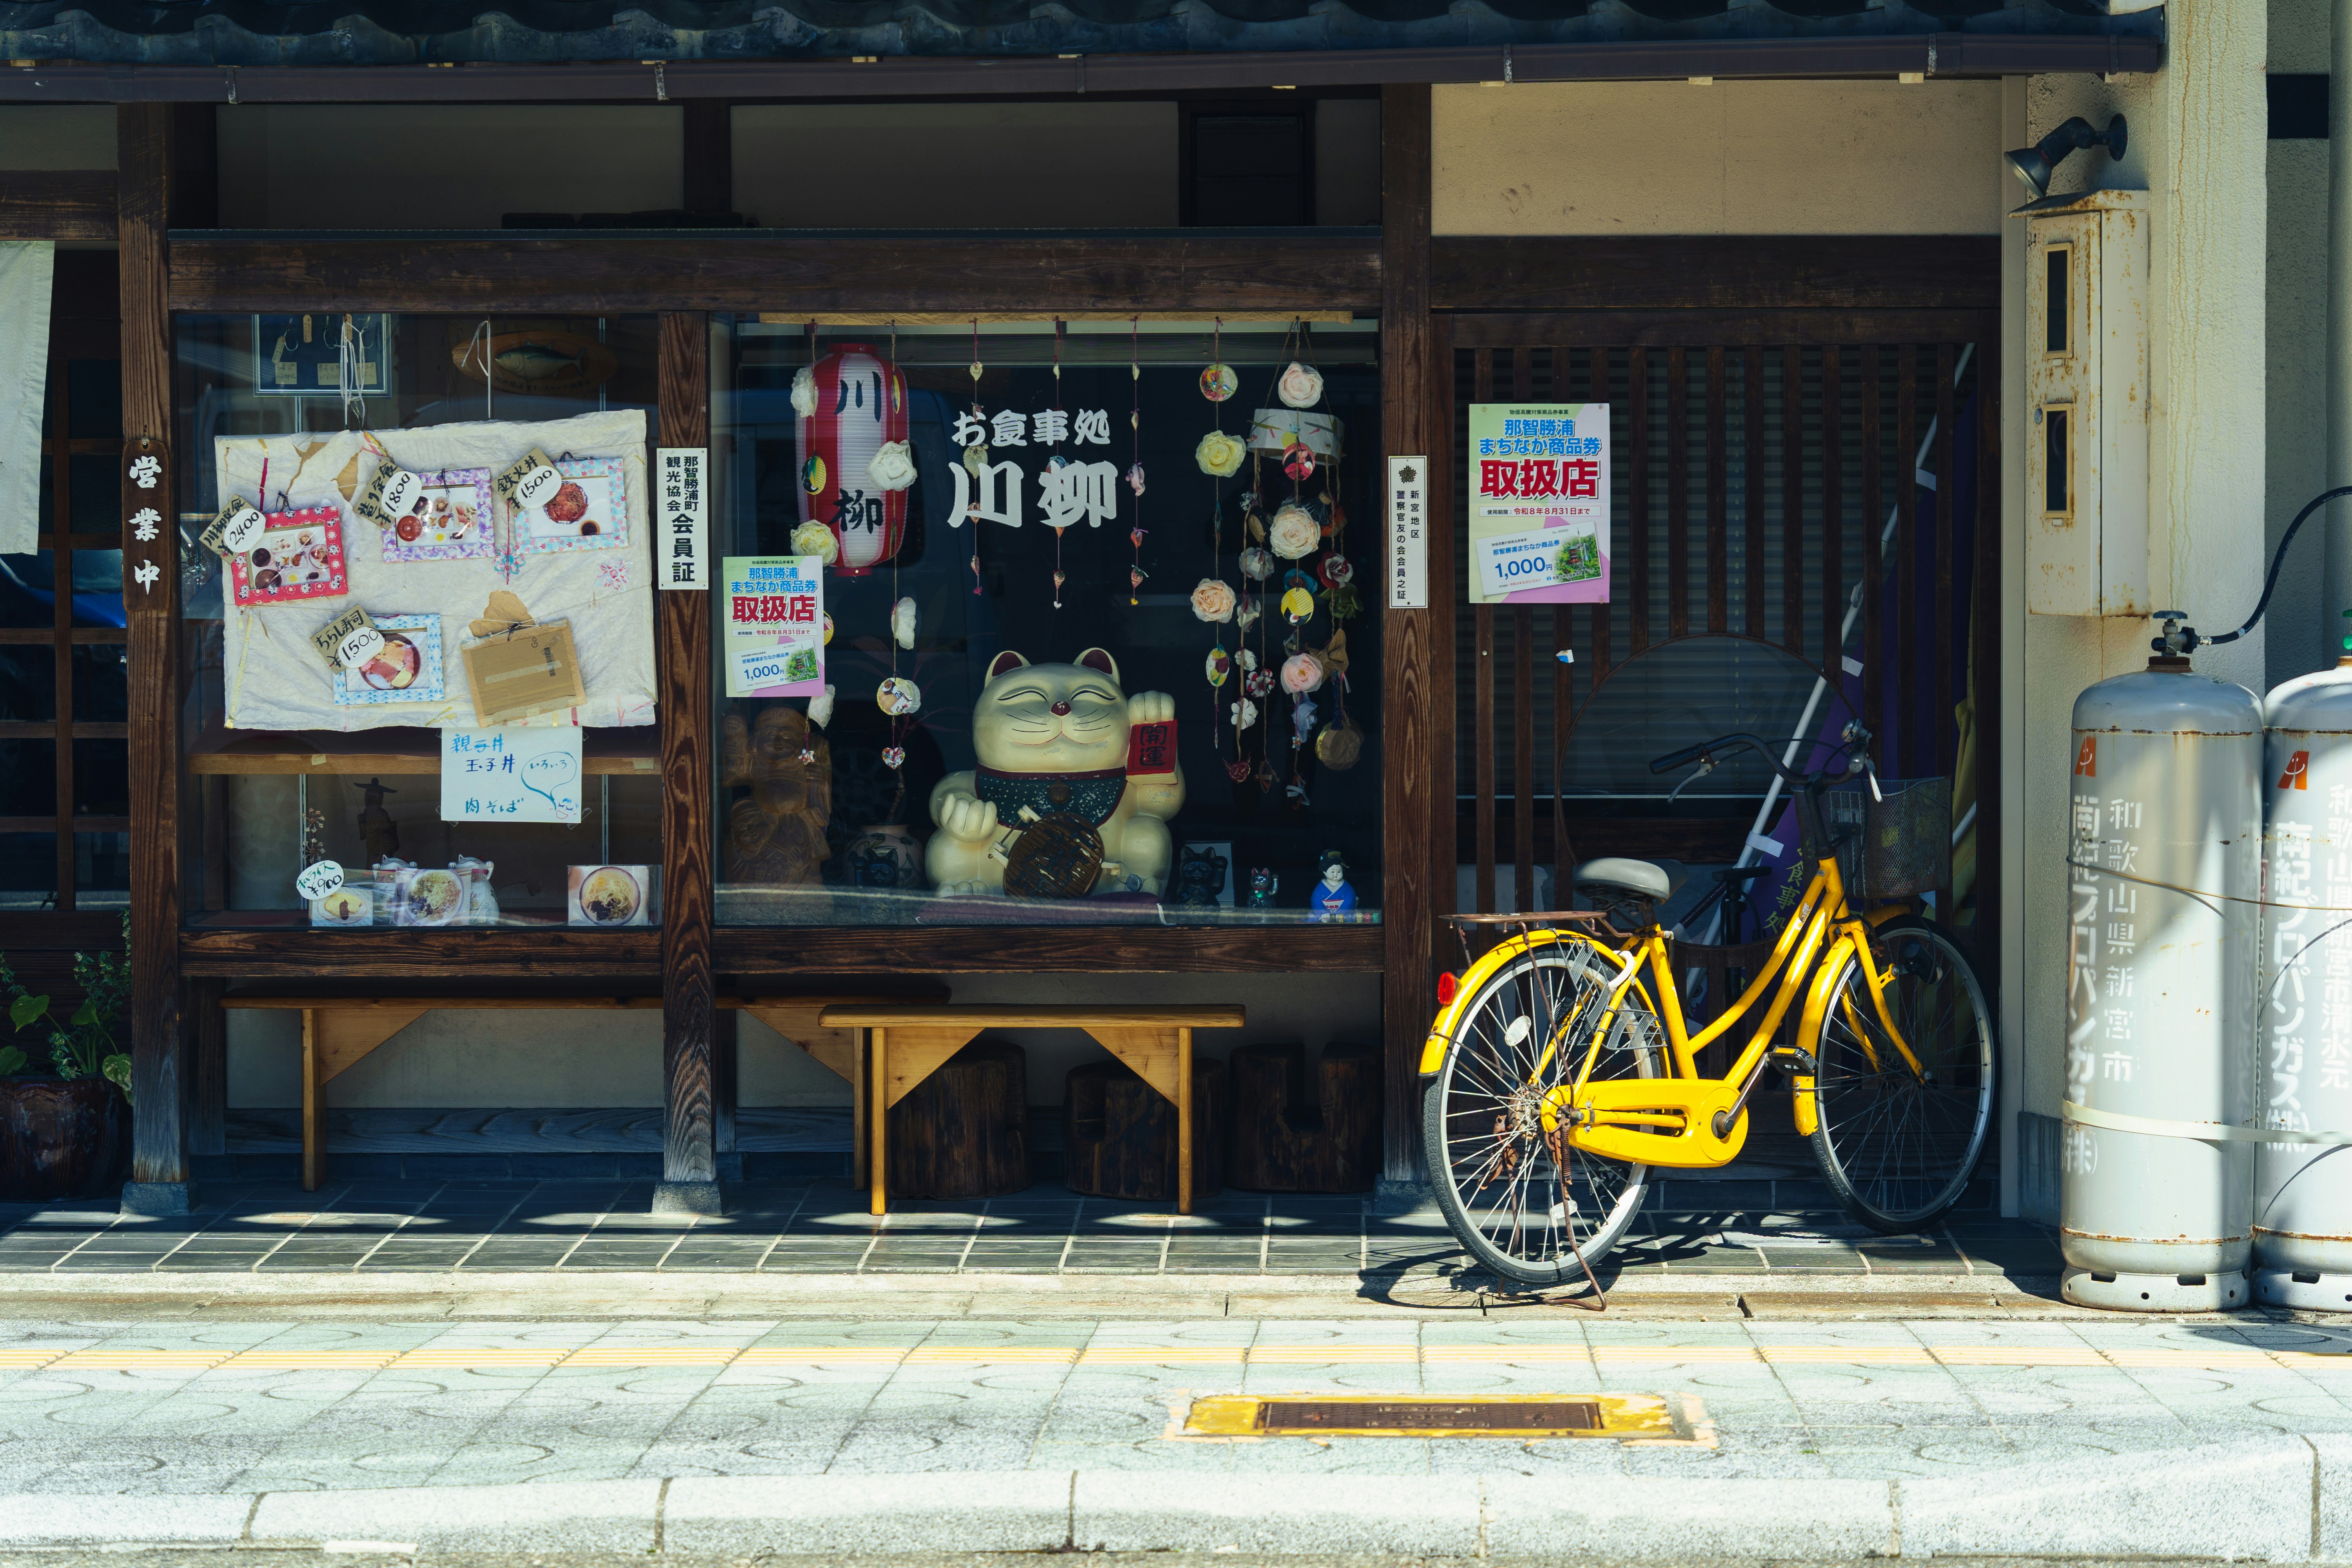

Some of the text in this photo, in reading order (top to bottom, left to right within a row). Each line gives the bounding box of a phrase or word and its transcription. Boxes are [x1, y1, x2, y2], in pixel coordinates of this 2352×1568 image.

[951, 408, 1111, 446] お食事処
[1504, 419, 1575, 437] 那智勝浦
[829, 371, 883, 534] 川柳
[1479, 437, 1602, 456] まちなか商品券
[666, 456, 681, 512] 観光協会
[684, 456, 699, 512] 那智勝浦町
[947, 460, 1118, 528] 川柳
[1479, 458, 1601, 500] 取扱店
[129, 456, 162, 595] 営業中
[1410, 490, 1420, 538] 新宮地区
[671, 513, 695, 583] 会員証
[1396, 490, 1406, 599] 警察官友の会会員之証
[1493, 539, 1560, 556] 那智勝浦まちなか商品券
[749, 566, 799, 580] 那智勝浦
[1495, 557, 1553, 580] 1,000円
[731, 579, 818, 593] まちなか商品券
[731, 594, 817, 625] 取扱店
[316, 610, 364, 651] ちらし寿司
[744, 664, 784, 681] 1,000円
[450, 733, 504, 753] 親子丼
[1139, 724, 1168, 767] 開運
[465, 754, 515, 773] 玉子丼
[465, 797, 524, 814] 肉そば
[297, 862, 336, 889] オムライス
[307, 875, 342, 897] ¥900
[2102, 798, 2142, 1082] 和歌山県新宮市
